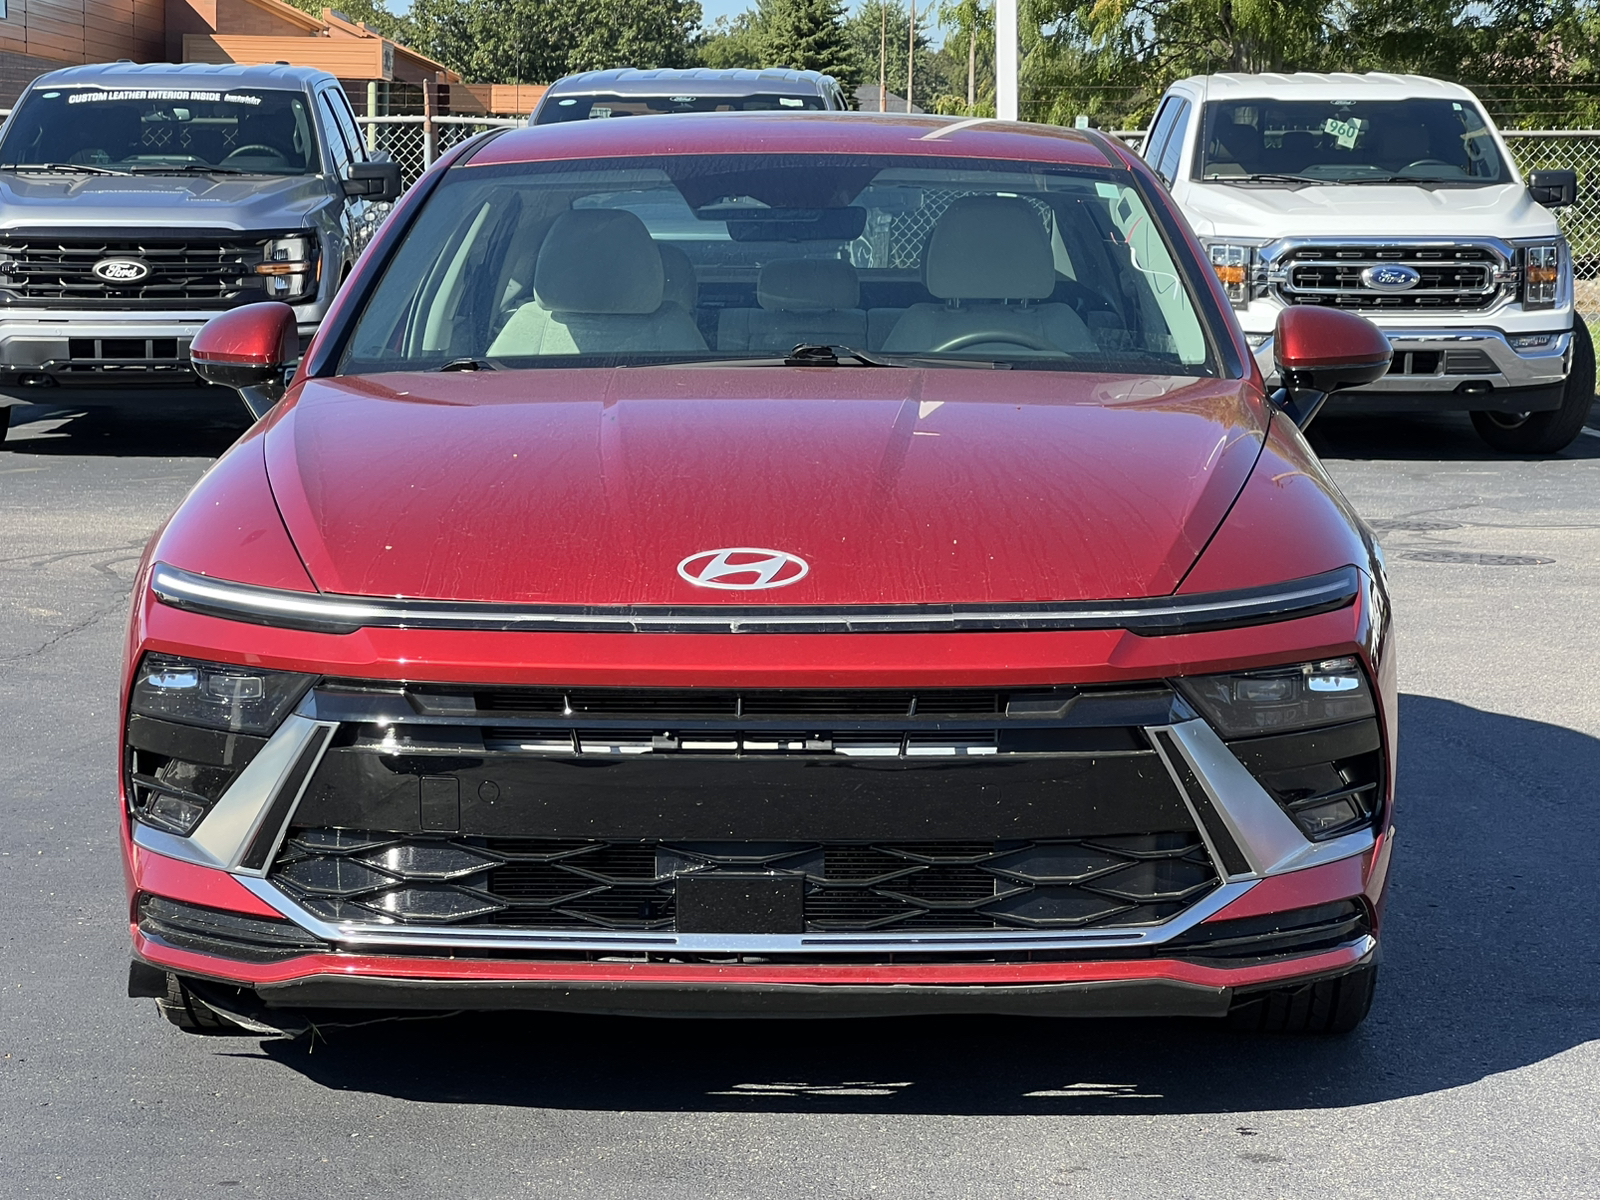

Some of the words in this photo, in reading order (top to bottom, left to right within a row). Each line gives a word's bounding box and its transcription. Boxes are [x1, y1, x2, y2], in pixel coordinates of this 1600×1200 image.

[68, 92, 107, 104] CUSTOM
[107, 90, 147, 101] LEATHER
[147, 90, 189, 100] INTERIOR
[189, 91, 220, 102] INSIDE
[1330, 120, 1355, 139] 960
[106, 264, 138, 278] Ford
[1379, 269, 1406, 283] Ford
